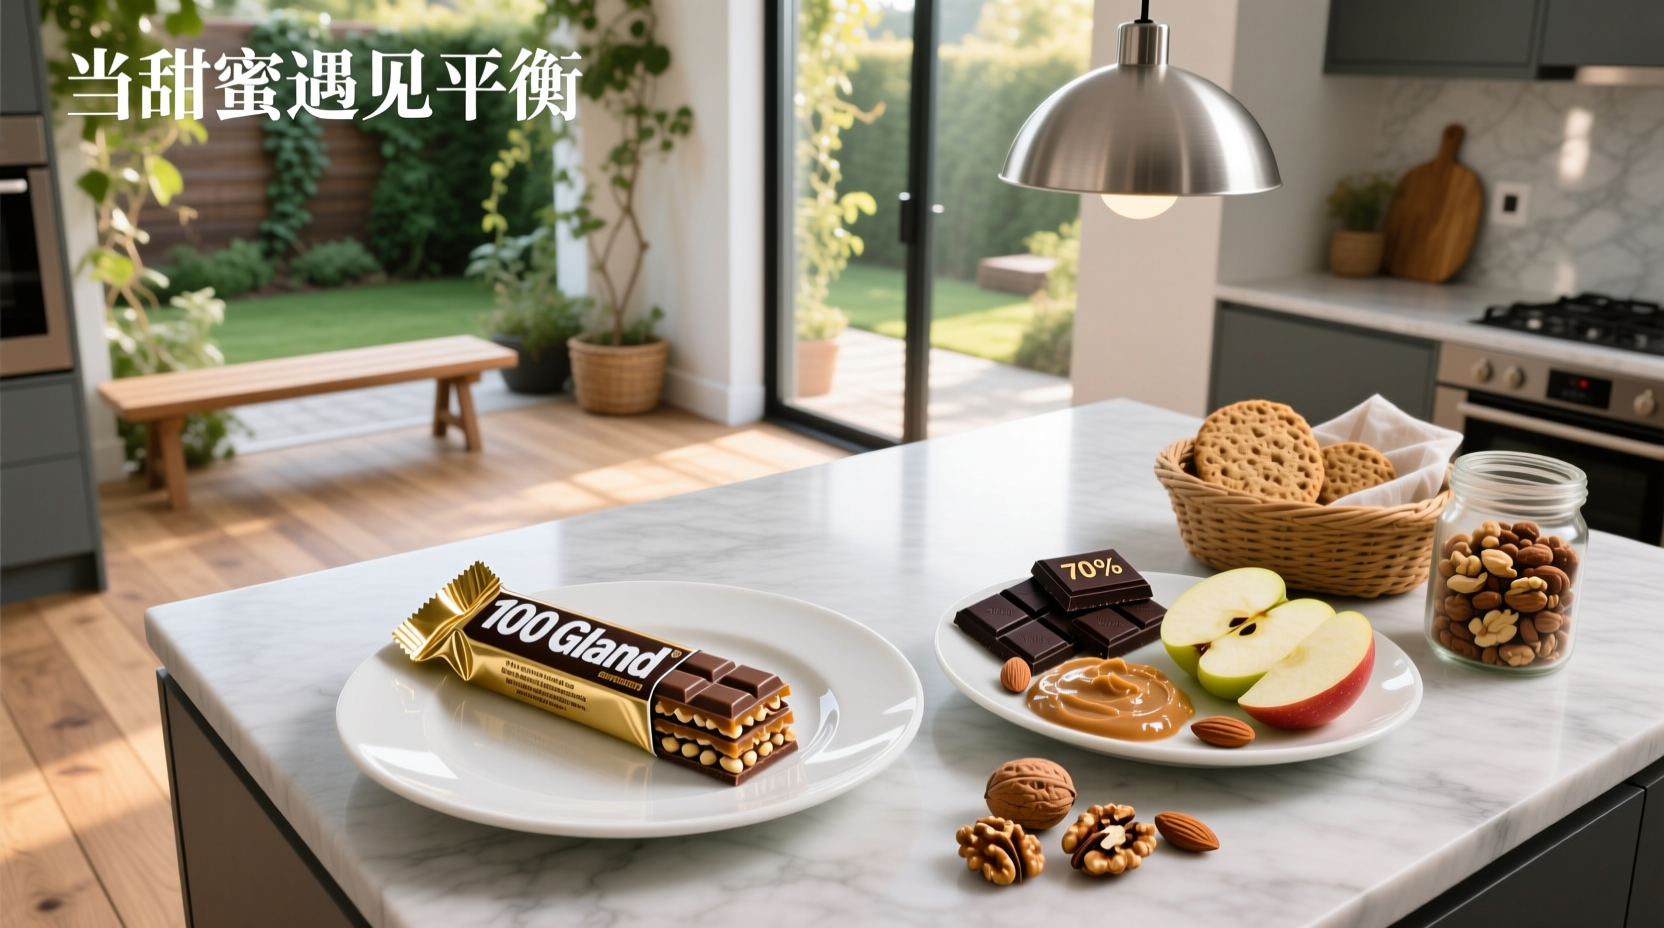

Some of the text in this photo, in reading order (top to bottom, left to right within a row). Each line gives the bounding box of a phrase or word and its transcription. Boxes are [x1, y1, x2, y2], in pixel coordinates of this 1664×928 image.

[1060, 557, 1123, 581] 70%
[481, 599, 560, 643] 100
[548, 620, 673, 679] Gland
